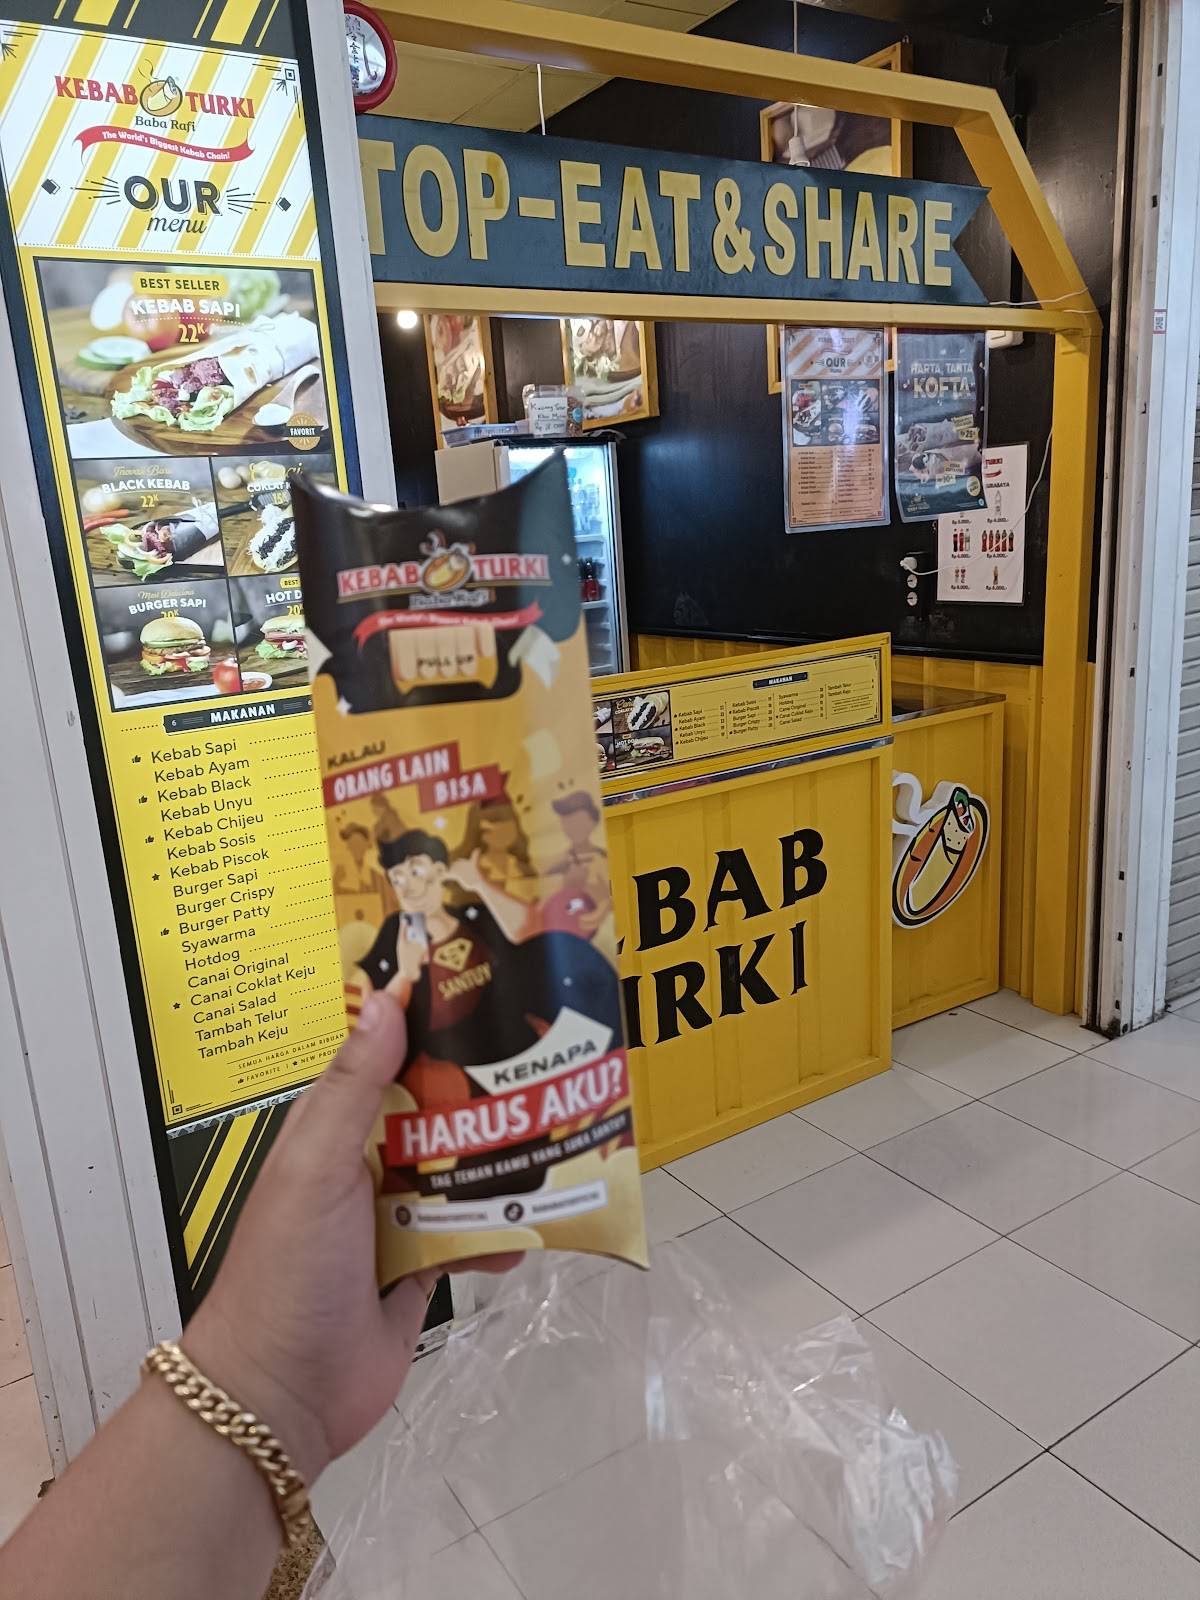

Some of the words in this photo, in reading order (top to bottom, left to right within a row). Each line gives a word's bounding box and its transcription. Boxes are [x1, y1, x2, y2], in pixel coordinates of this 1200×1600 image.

[54, 76, 138, 106] KEBAB
[185, 92, 255, 119] TURKI
[135, 116, 168, 128] Baba
[170, 120, 196, 132] Rafi
[102, 131, 117, 140] The
[118, 131, 148, 144] World's
[150, 137, 178, 152] Biggest
[180, 146, 205, 158] Kebab
[206, 151, 230, 160] Chain!
[124, 175, 223, 216] OUR
[147, 216, 207, 234] menu
[140, 278, 170, 290] BEST
[175, 279, 220, 291] SELLER
[131, 298, 195, 315] KEBAB
[200, 301, 240, 318] SAPI
[826, 358, 846, 368] OUR
[914, 376, 971, 398] KOFTA
[290, 428, 316, 436] FAVORIT
[102, 478, 146, 494] BLACK
[147, 478, 190, 490] KEBAB
[337, 564, 419, 595] KEBAB
[474, 554, 549, 580] TURKI
[128, 599, 178, 615] BURGER
[180, 598, 207, 608] SAPI
[266, 591, 292, 604] HOT
[417, 656, 452, 668] PULL
[456, 654, 474, 666] UP
[210, 704, 276, 724] MAKANAN
[151, 746, 201, 764] Kebab
[205, 739, 237, 756] Sapi
[327, 742, 386, 770] KALAU
[154, 764, 204, 783] Kebab
[208, 758, 250, 776] Ayam
[334, 761, 393, 800] ORANG
[400, 749, 450, 781] LAIN
[157, 784, 207, 802] Kebab
[211, 776, 251, 793] Black
[434, 773, 487, 803] BISA
[160, 804, 210, 822] Kebab
[214, 796, 253, 812] Unyu
[164, 822, 213, 841] Kebab
[217, 814, 264, 830] Chijeu
[167, 842, 216, 860] Kebab
[219, 833, 256, 849] Sosis
[170, 860, 219, 879] Kebab
[223, 848, 270, 868] Piscok
[173, 878, 224, 897] Burger
[227, 868, 258, 887] Sapi
[617, 828, 827, 954] BAB
[176, 896, 226, 916] Burger
[230, 885, 275, 904] Crispy
[179, 914, 229, 935] Burger
[233, 905, 270, 922] Patty
[181, 927, 256, 953] Syawarma
[185, 949, 240, 971] Hotdog
[188, 968, 230, 988] Canai
[234, 953, 289, 976] Original
[190, 986, 232, 1006] Canai
[236, 975, 282, 995] Coklat
[286, 965, 316, 981] Keju
[193, 1003, 236, 1025] Canai
[239, 992, 276, 1012] Salad
[195, 1018, 252, 1042] Tambah
[255, 1008, 289, 1025] Telur
[198, 1035, 254, 1059] Tambah
[258, 1025, 289, 1041] Keju
[238, 1058, 262, 1069] SEMUA
[266, 1050, 289, 1061] HARGA
[292, 1042, 316, 1053] DALAM
[319, 1032, 344, 1045] RIBUAN
[246, 1066, 280, 1082] FAVORITE
[300, 1056, 316, 1064] NEW
[319, 1049, 338, 1058] PROD
[493, 1039, 598, 1087] KENAPA
[402, 1094, 530, 1158] HARUS
[540, 1058, 624, 1128] AKU?
[430, 1174, 453, 1189] TAG
[454, 1165, 493, 1185] TEMAN
[495, 1154, 530, 1176] KAMU
[532, 1144, 562, 1164] YANG
